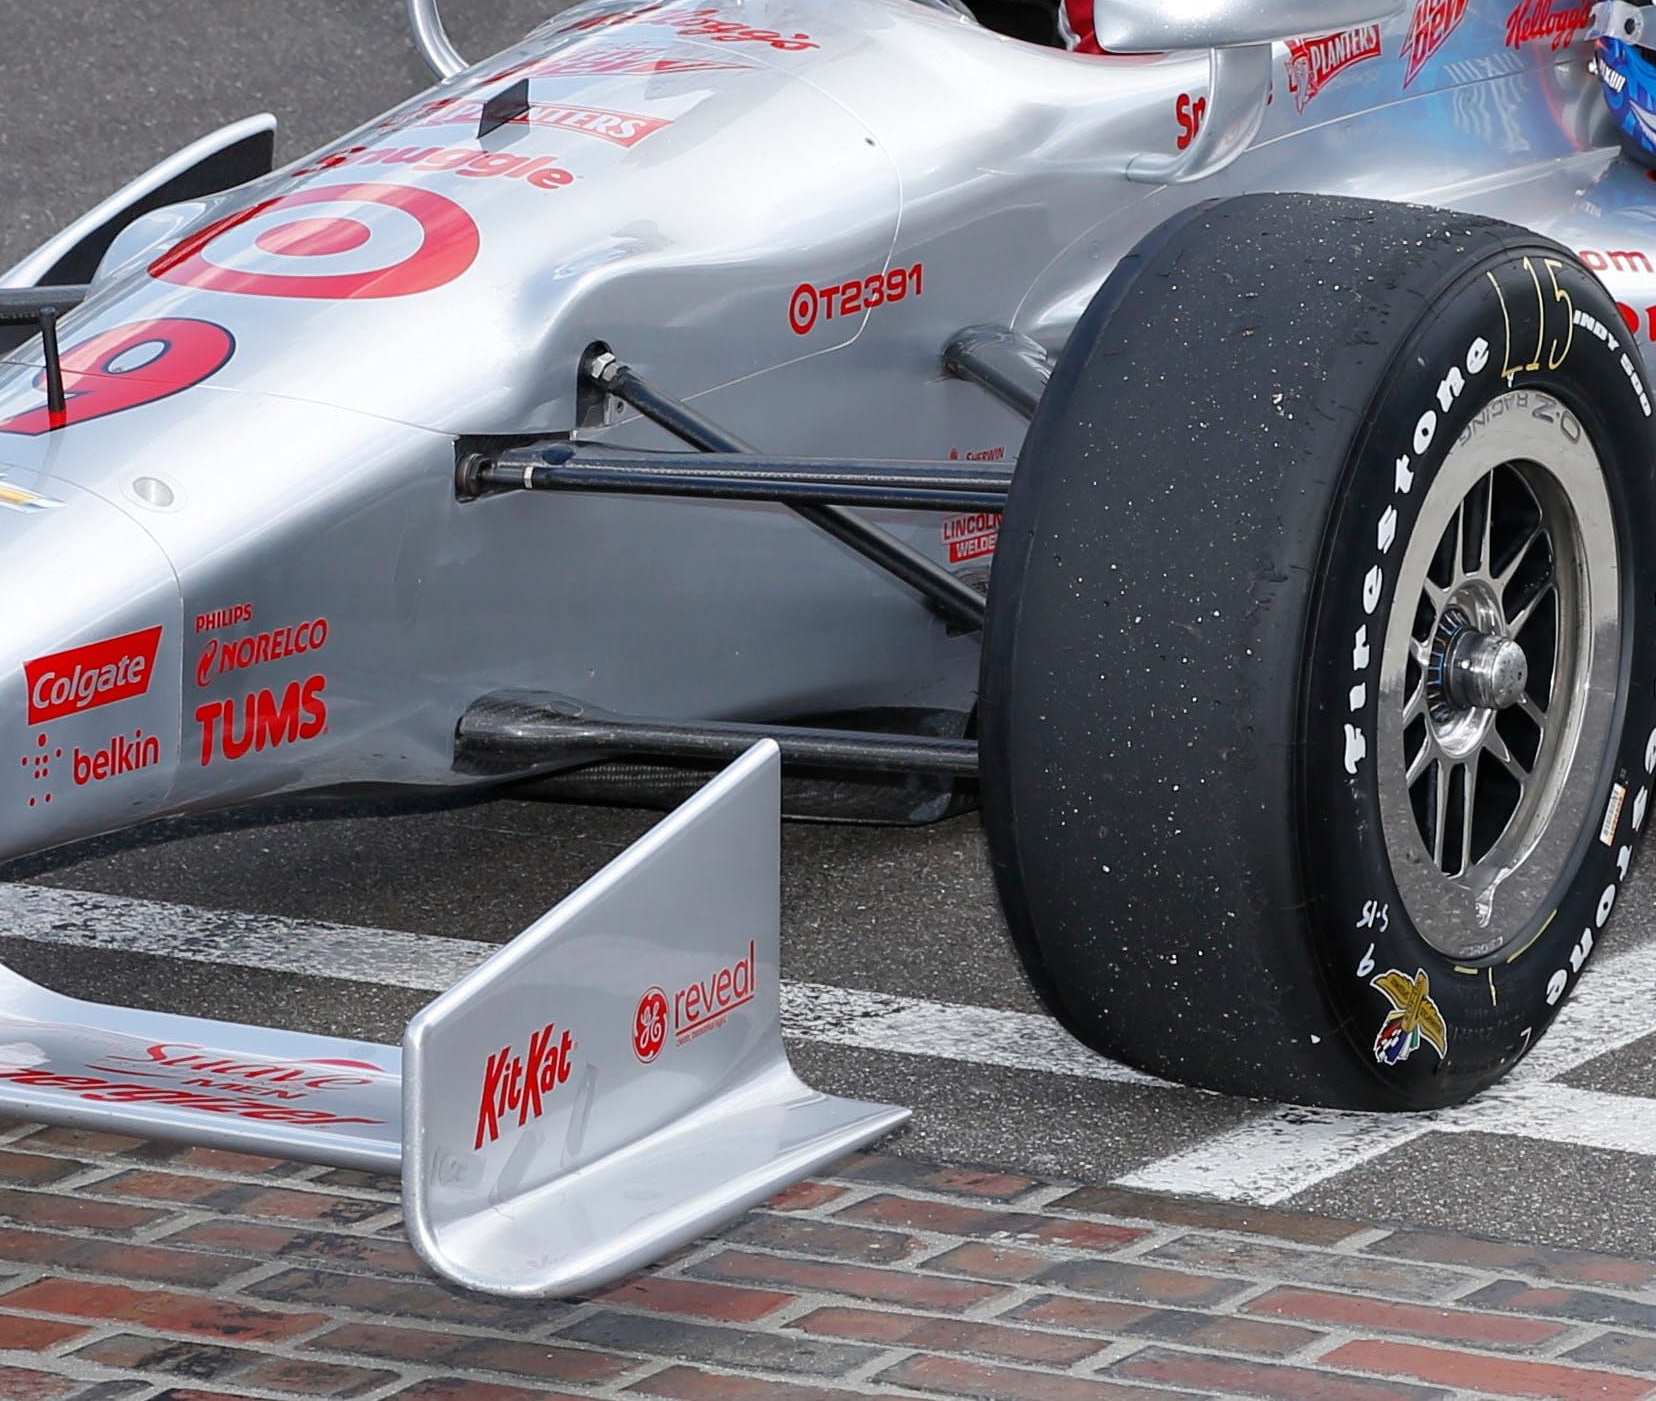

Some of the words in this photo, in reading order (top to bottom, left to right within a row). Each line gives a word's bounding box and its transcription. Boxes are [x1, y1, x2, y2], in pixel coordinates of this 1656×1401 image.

[1310, 26, 1378, 81] PLANTERS
[818, 263, 924, 320] T2391
[1572, 309, 1622, 352] INDY
[1620, 353, 1653, 418] 500
[1458, 393, 1529, 447] RACING
[944, 511, 1004, 541] LINCOLN
[955, 535, 996, 559] WELDE
[1345, 337, 1490, 775] Firestone
[195, 602, 253, 634] PHILIPS
[219, 617, 329, 674] NORELCO
[31, 653, 147, 712] Colgate
[194, 674, 327, 767] TUMS
[72, 728, 161, 786] belkin
[673, 938, 756, 1031] reveal
[181, 1077, 308, 1101] MEN
[475, 1023, 574, 1151] KitKat
